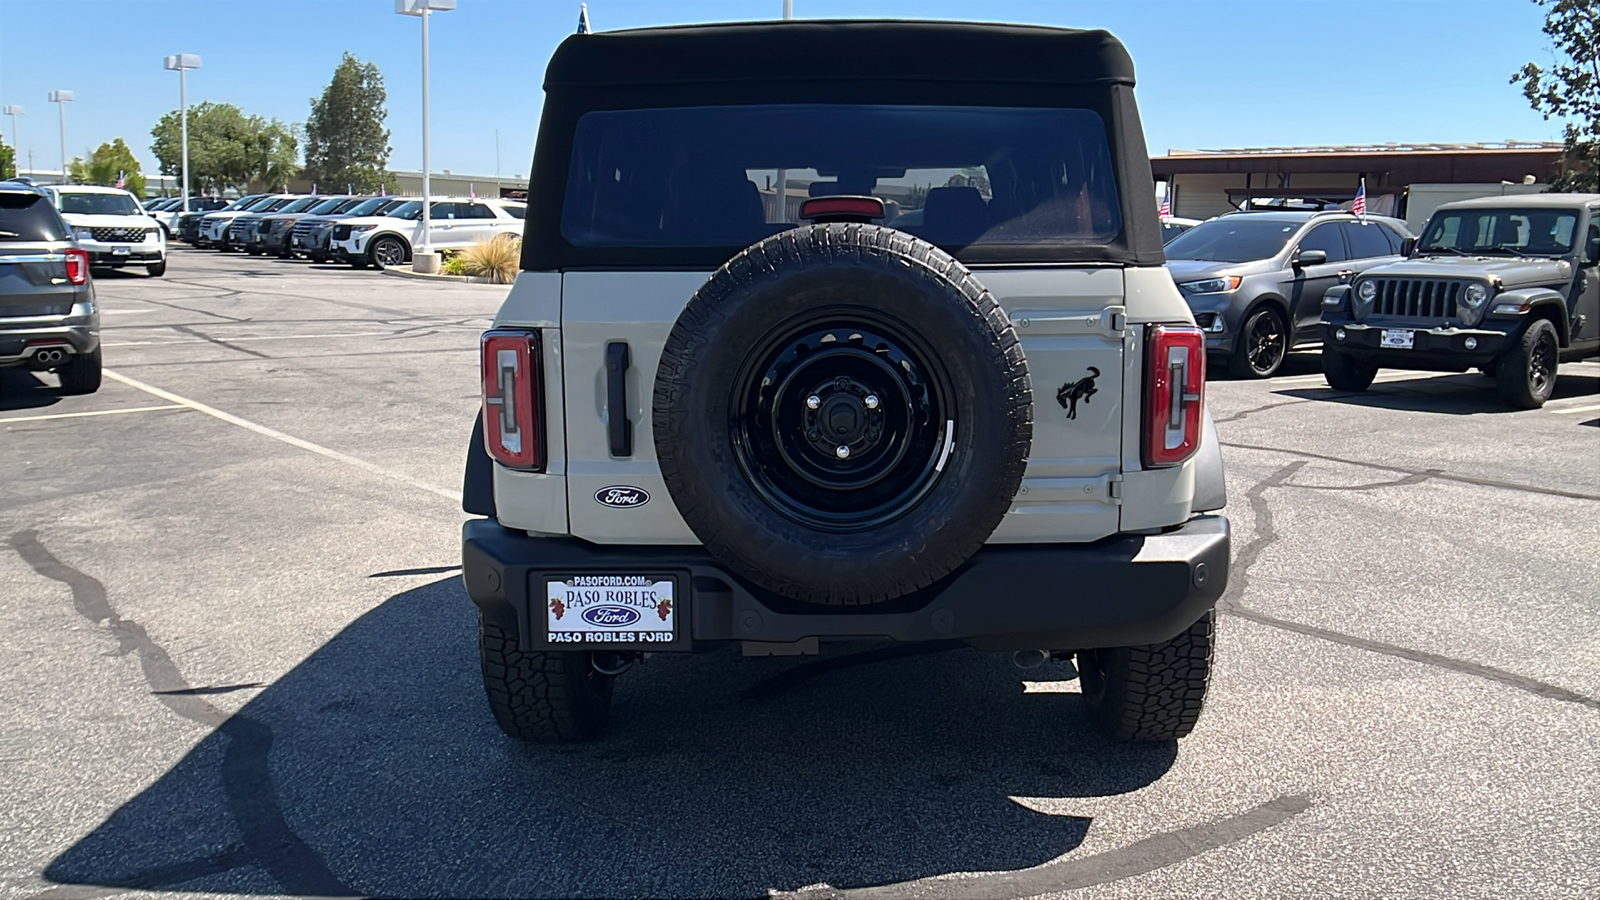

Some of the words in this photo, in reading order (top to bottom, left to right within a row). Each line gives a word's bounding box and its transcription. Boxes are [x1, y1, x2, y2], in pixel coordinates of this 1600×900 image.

[605, 489, 639, 504] Ford
[574, 576, 646, 587] PASOFORD.COM
[566, 590, 600, 609] PASO
[605, 590, 657, 609] ROBLES
[593, 607, 630, 623] Ford
[548, 632, 582, 643] PASO
[585, 632, 636, 642] ROBLES
[639, 632, 673, 642] FORD
